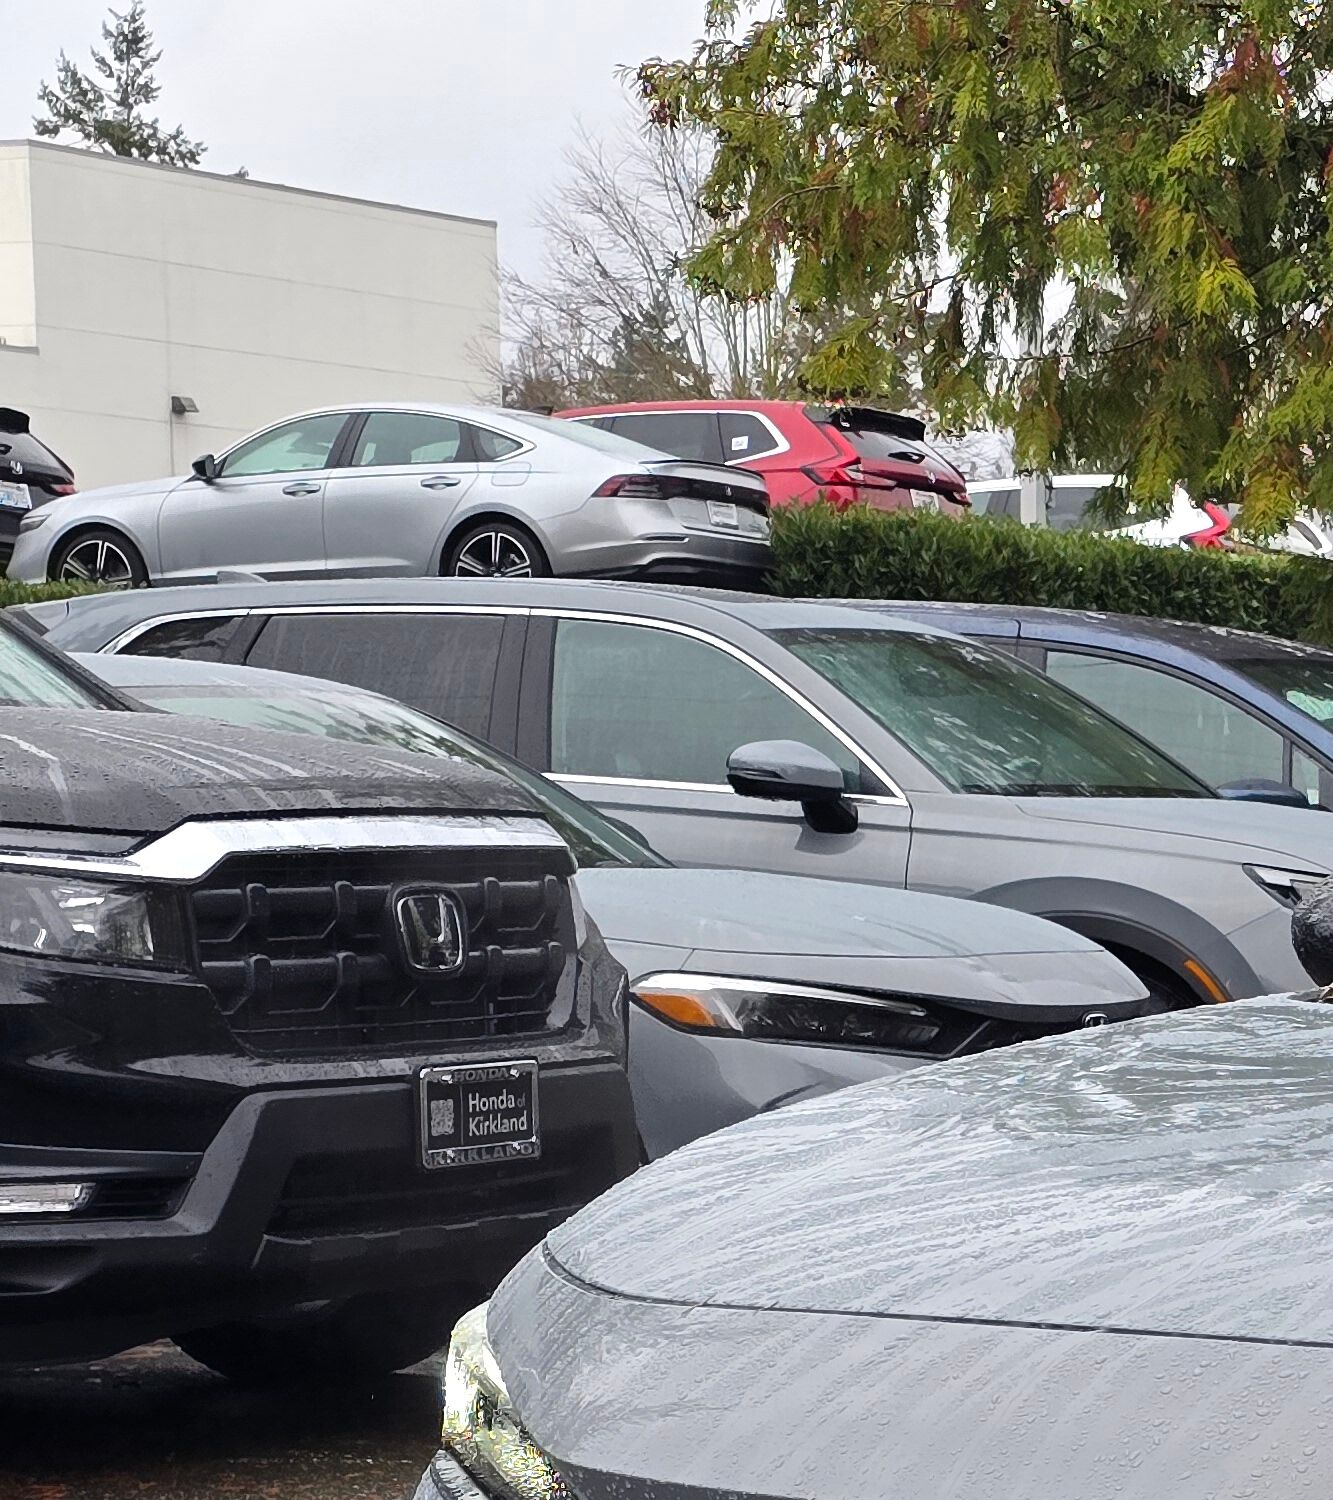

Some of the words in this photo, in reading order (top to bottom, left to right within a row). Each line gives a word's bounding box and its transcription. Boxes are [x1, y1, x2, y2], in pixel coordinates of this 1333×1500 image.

[455, 1068, 510, 1081] HONDA
[468, 1089, 515, 1113] Honda
[517, 1092, 526, 1107] of
[468, 1110, 527, 1137] Kirkland
